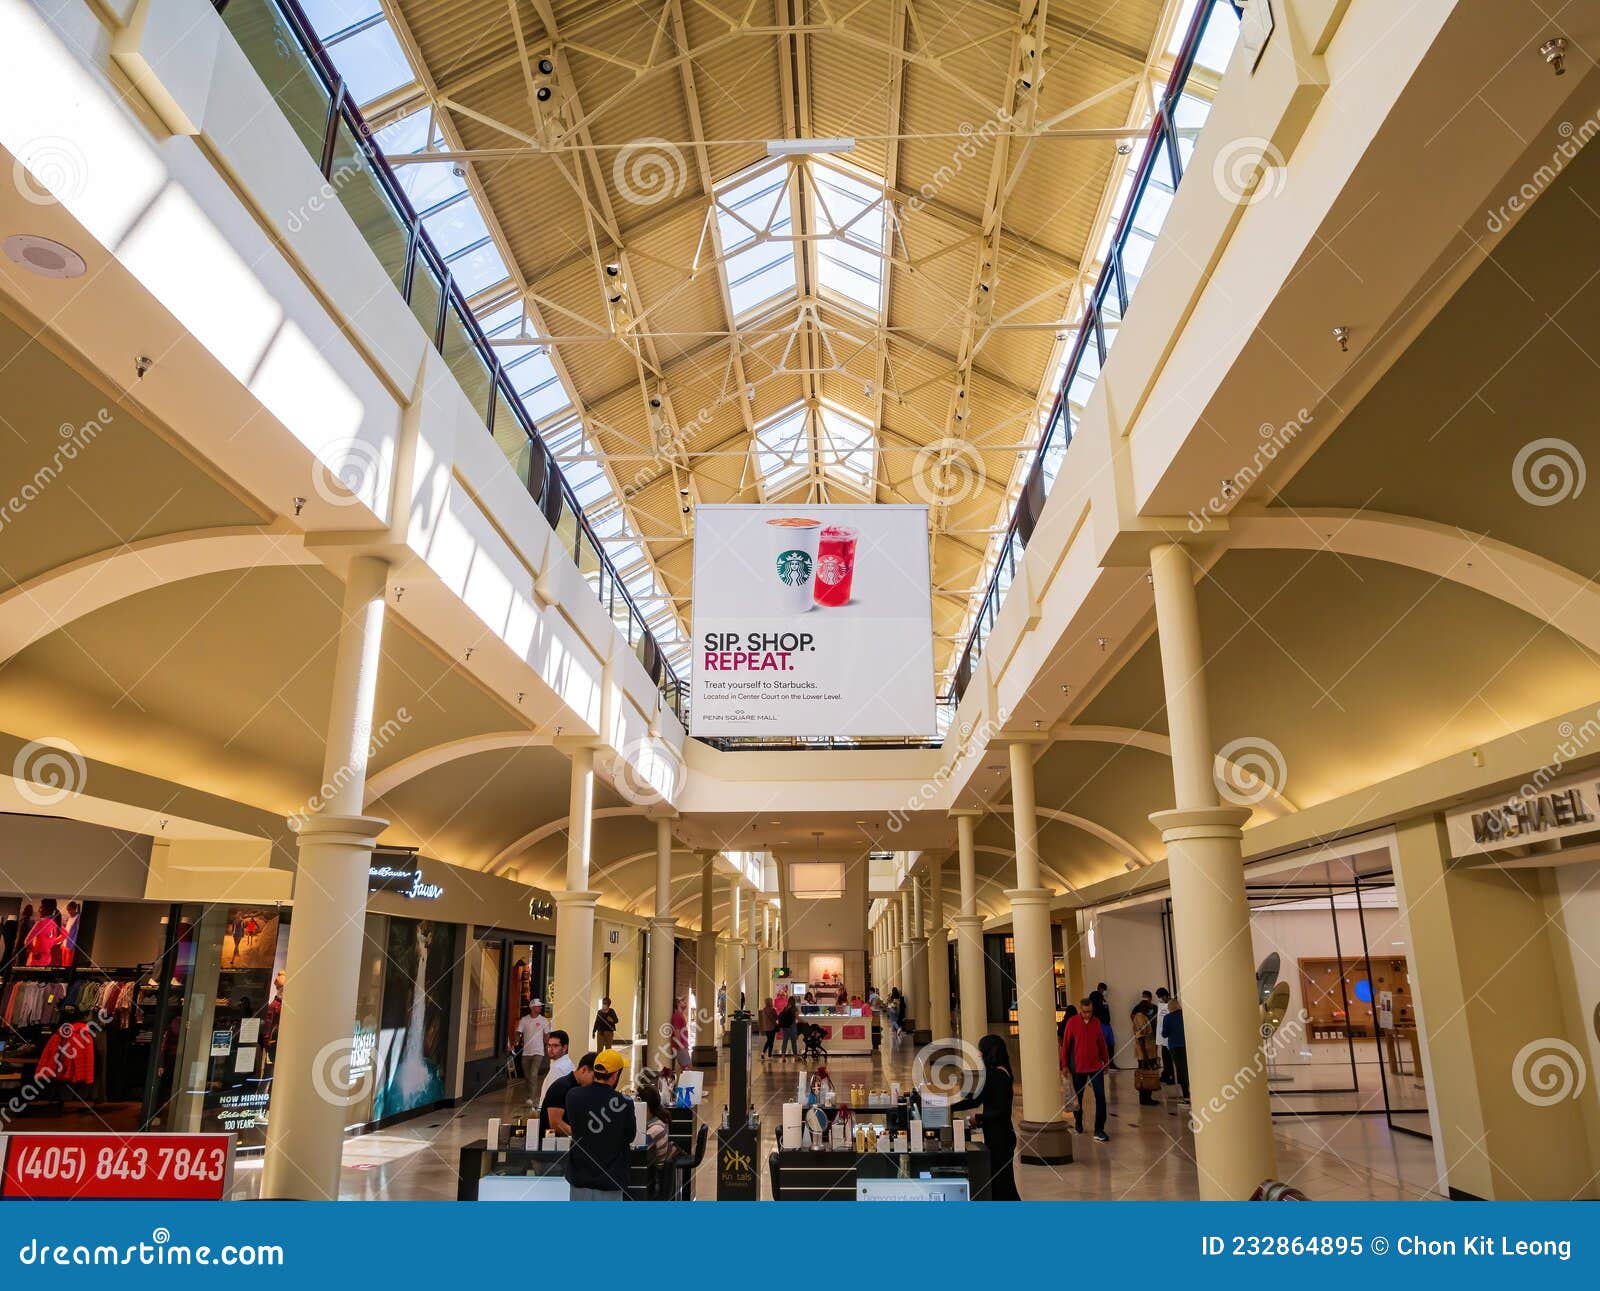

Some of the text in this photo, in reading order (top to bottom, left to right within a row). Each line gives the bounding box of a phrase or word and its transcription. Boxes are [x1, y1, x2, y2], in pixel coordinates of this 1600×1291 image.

[704, 632, 816, 652] SIP. SHOP.
[704, 652, 795, 671] REPEAT.
[704, 680, 818, 690] Treat yourself to Starbucks.
[220, 1096, 240, 1104] NOW
[240, 1094, 270, 1103] HIRING
[236, 1119, 256, 1129] YEARS
[17, 1146, 225, 1184] (405) 843 7843
